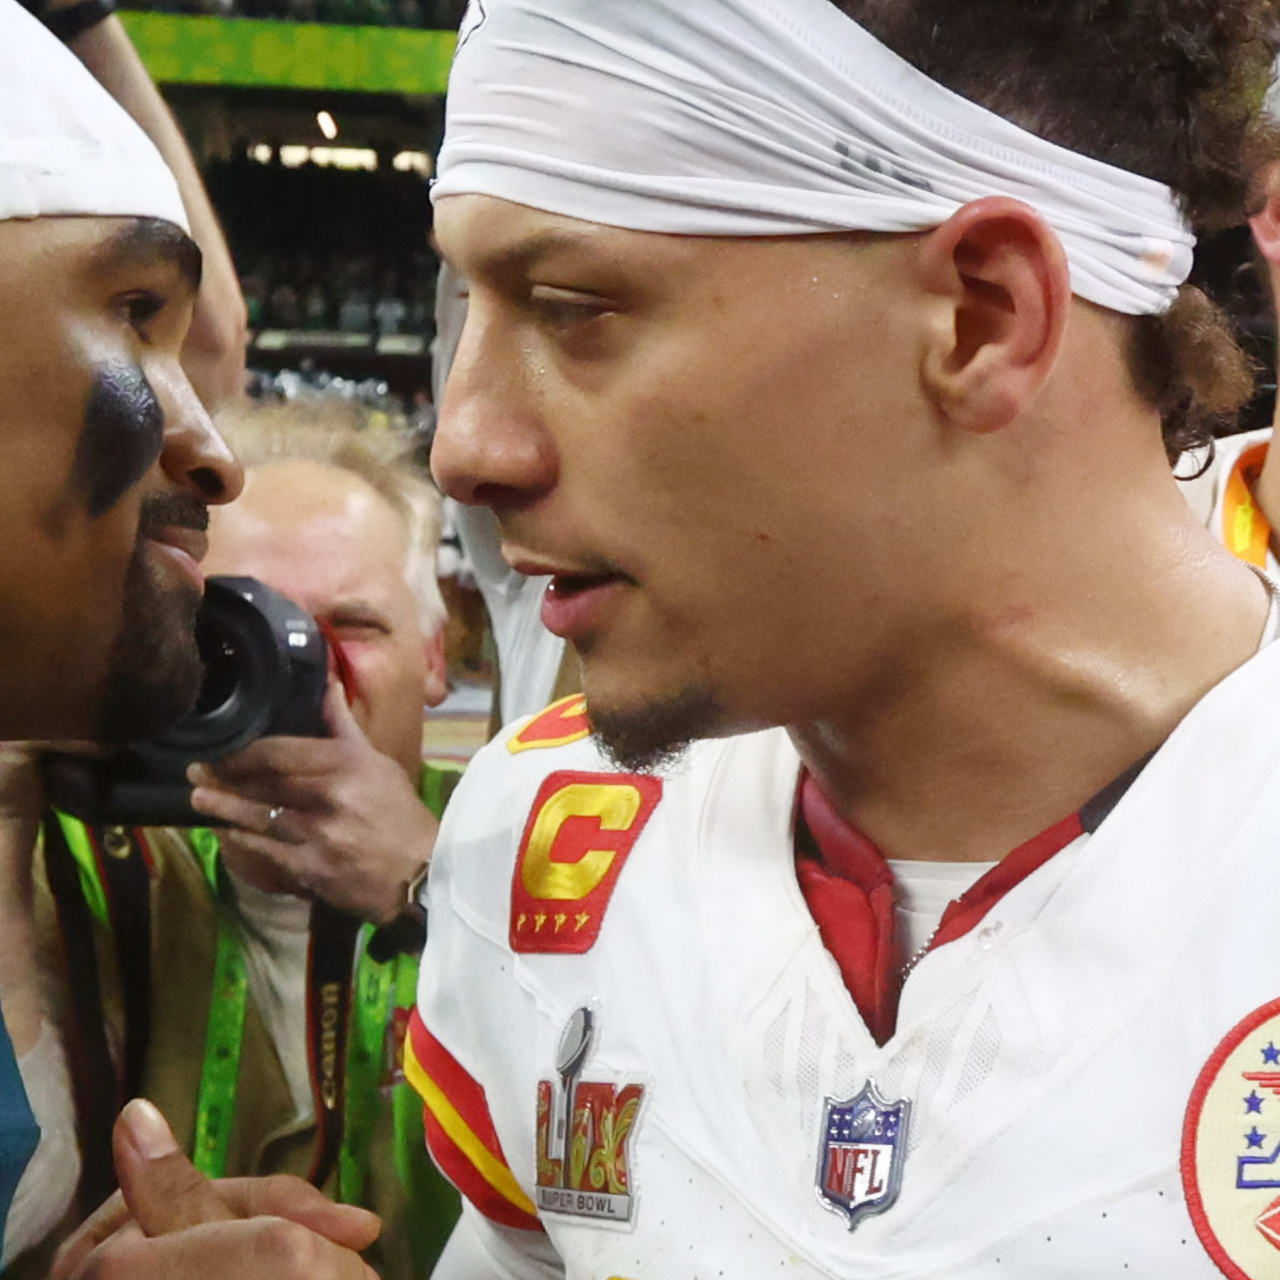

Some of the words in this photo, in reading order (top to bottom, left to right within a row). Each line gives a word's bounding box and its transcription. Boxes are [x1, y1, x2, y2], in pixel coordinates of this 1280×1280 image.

[521, 782, 642, 901] C
[826, 1145, 884, 1203] NFL
[576, 1194, 616, 1214] BOWL
